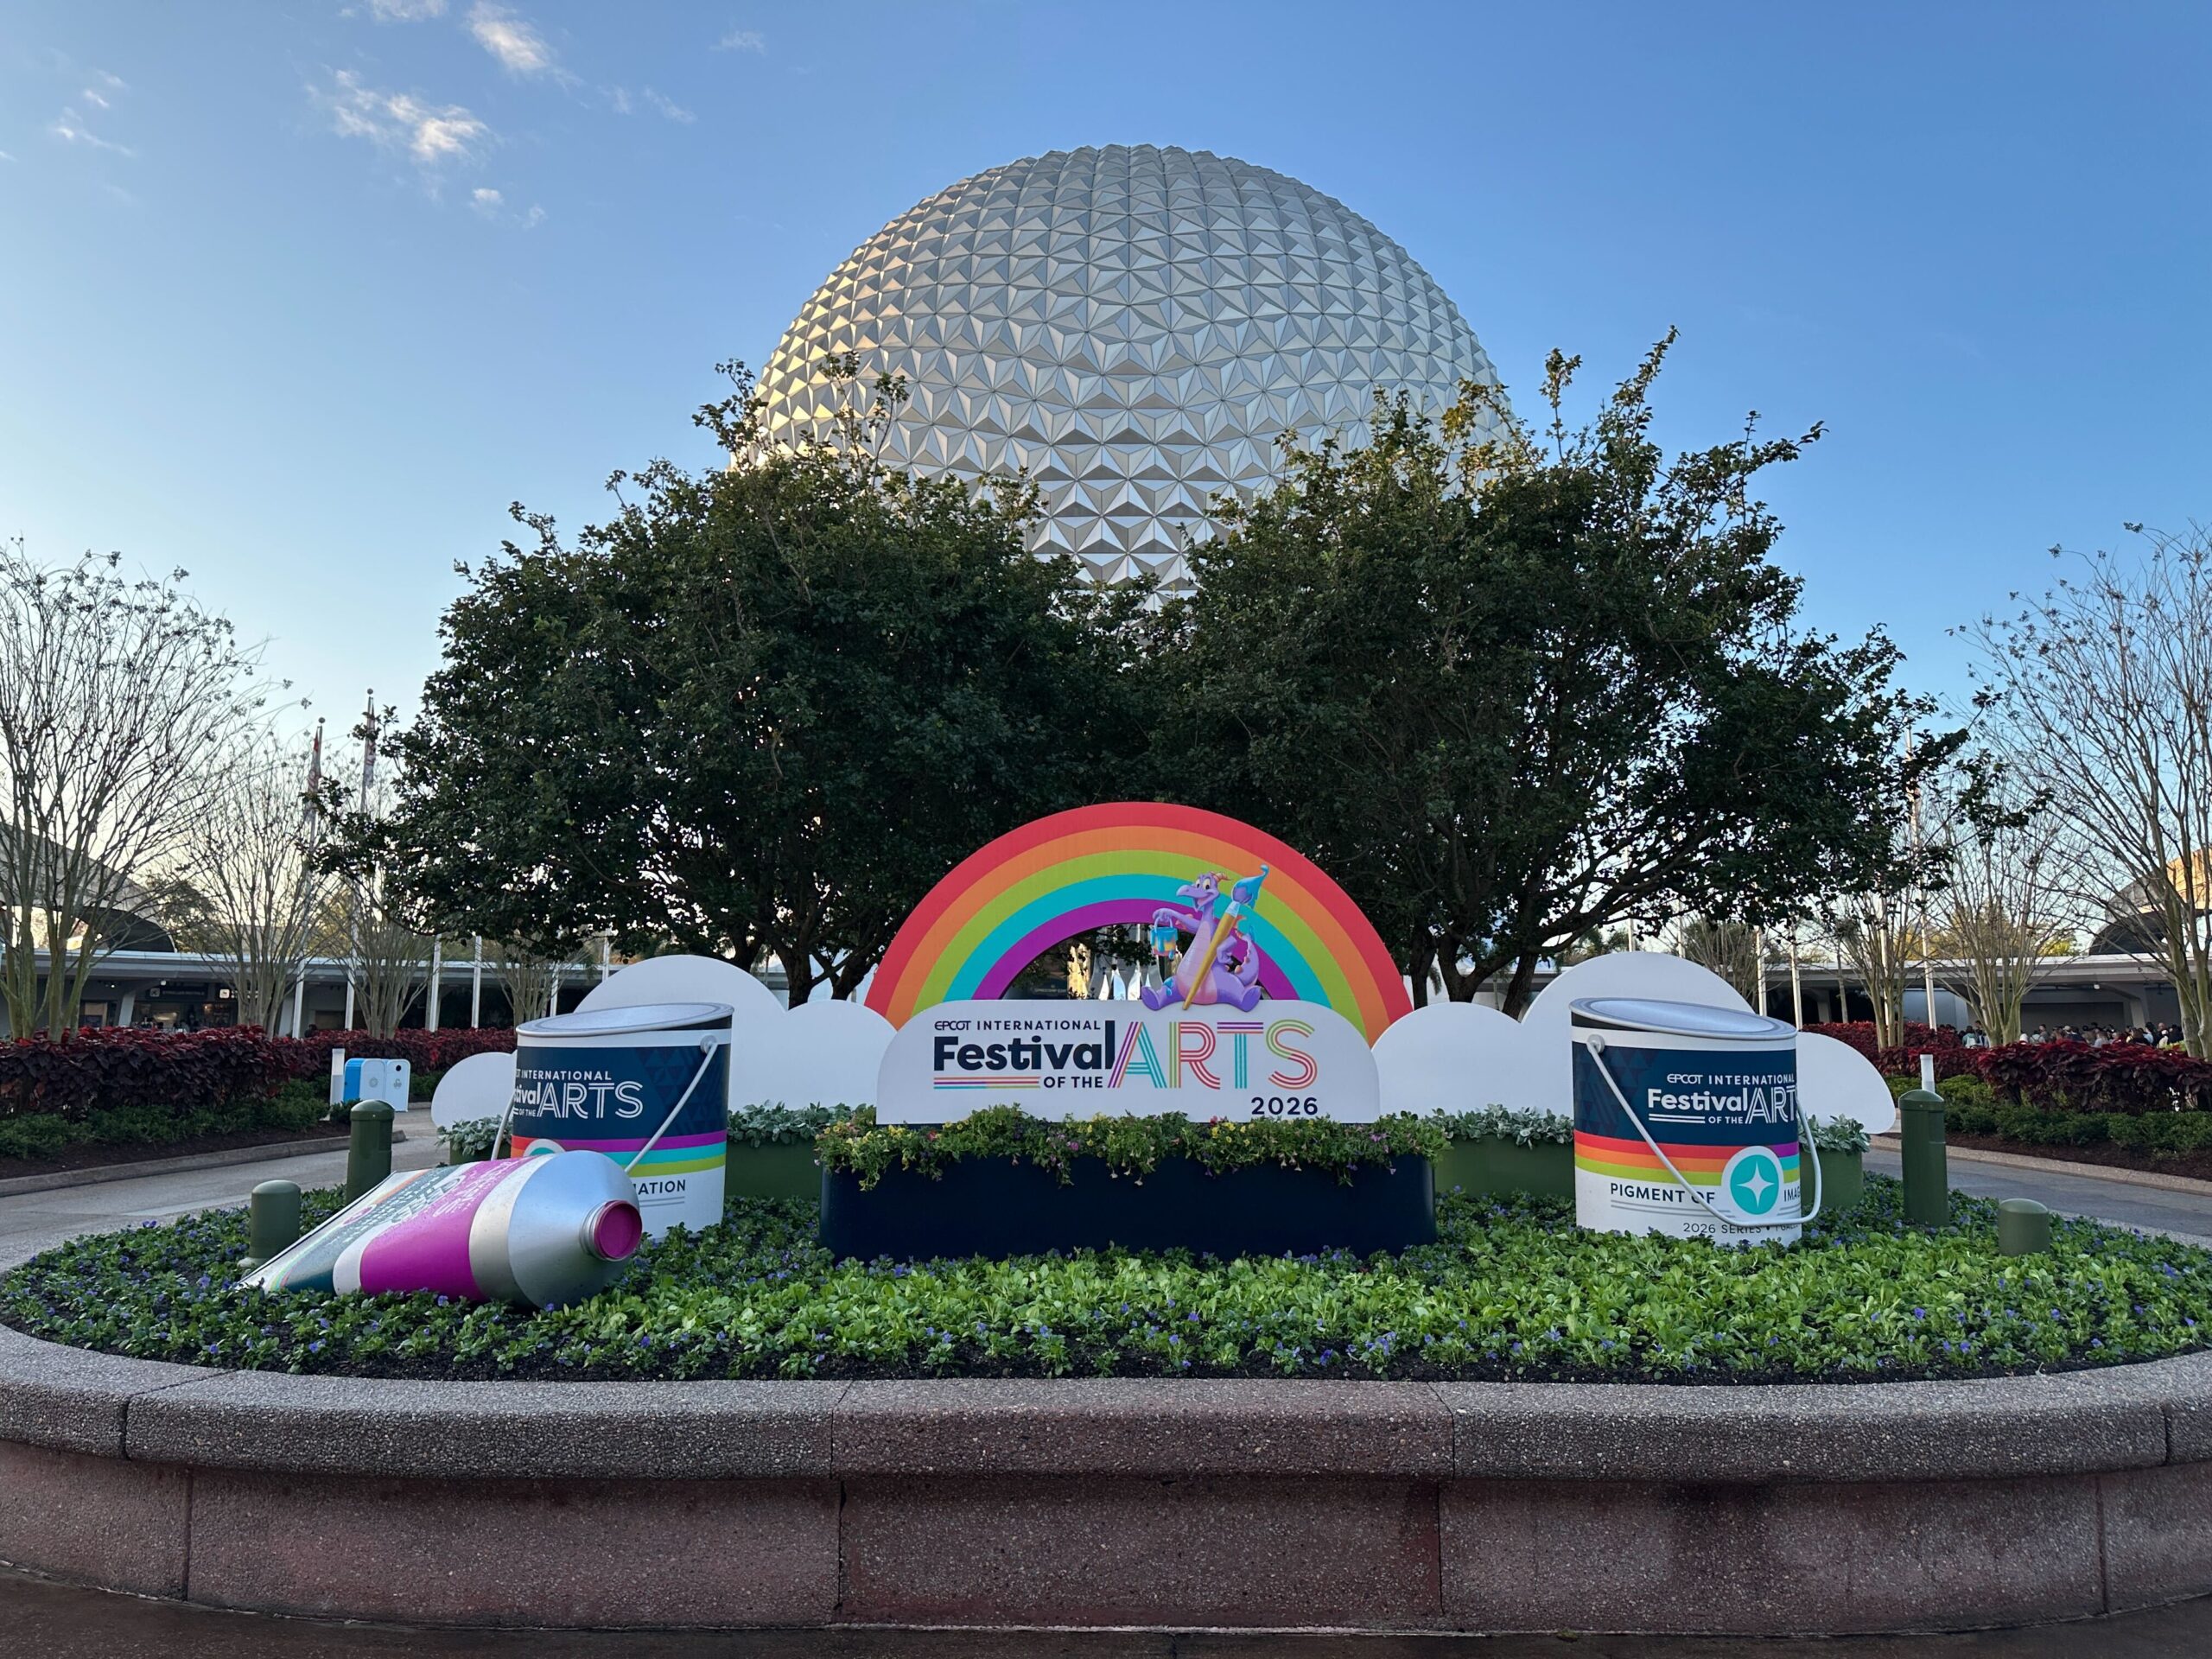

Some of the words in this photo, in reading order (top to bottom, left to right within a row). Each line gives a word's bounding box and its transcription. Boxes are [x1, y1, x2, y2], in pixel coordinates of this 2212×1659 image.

[934, 1020, 971, 1031] EPCOT
[977, 1020, 1101, 1030] INTERNATIONAL
[934, 1020, 1115, 1071] Festival
[1108, 1019, 1318, 1090] ARTS
[521, 1070, 612, 1080] INTERNATIONAL
[1044, 1077, 1065, 1088] OF
[1071, 1076, 1103, 1088] THE
[1667, 1073, 1703, 1084] EPCOT
[1709, 1073, 1795, 1085] INTERNATIONAL
[537, 1081, 643, 1119] ARTS
[1251, 1096, 1318, 1116] 2026
[1648, 1088, 1747, 1111] Festival
[633, 1179, 685, 1195] ATION
[1611, 1183, 1685, 1203] PIGMENT
[1691, 1192, 1715, 1204] OF
[1683, 1223, 1716, 1234] 2026
[1721, 1224, 1762, 1234] SERIES
